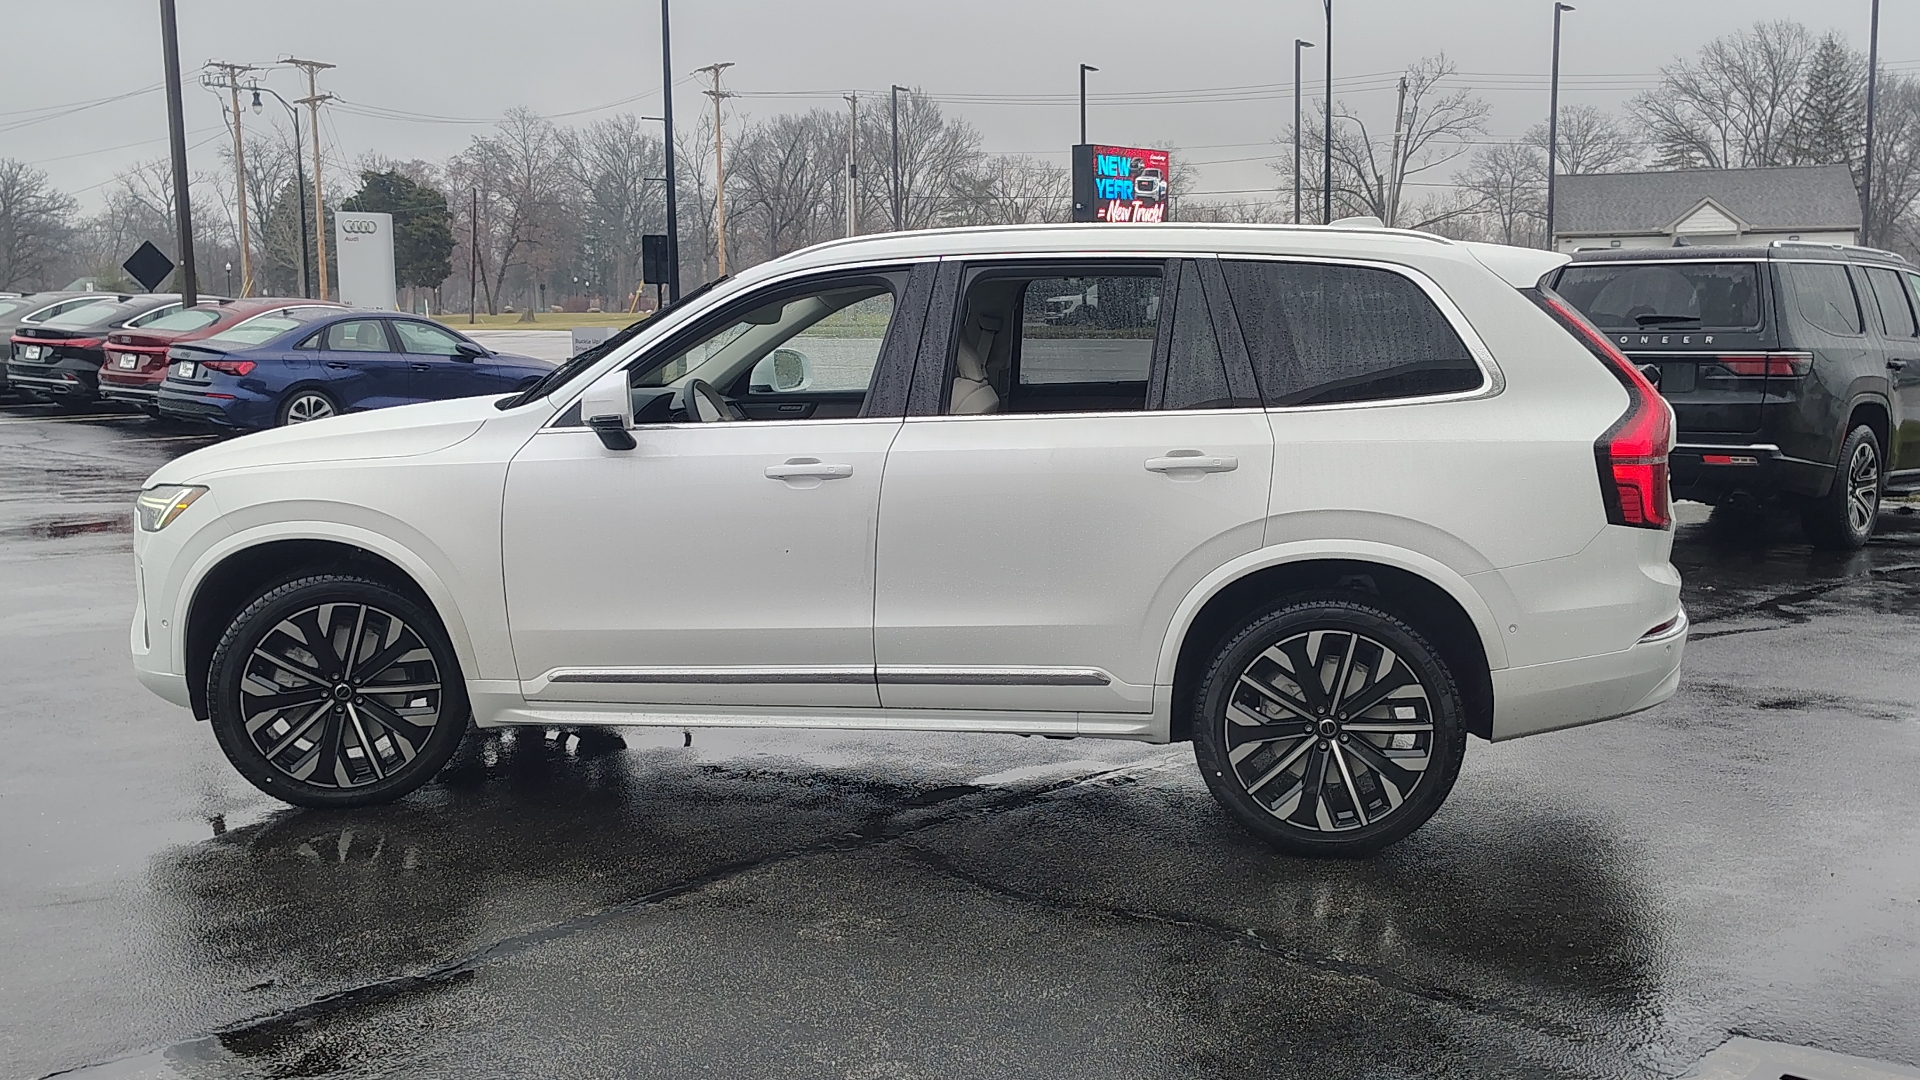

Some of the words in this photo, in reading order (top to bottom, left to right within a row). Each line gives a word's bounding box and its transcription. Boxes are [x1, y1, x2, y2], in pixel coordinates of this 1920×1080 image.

[1097, 154, 1131, 176] NEW
[1095, 178, 1133, 200] YEAR
[1106, 199, 1132, 223] New
[1131, 200, 1165, 223] Truck!
[1619, 335, 1714, 345] ONEER
